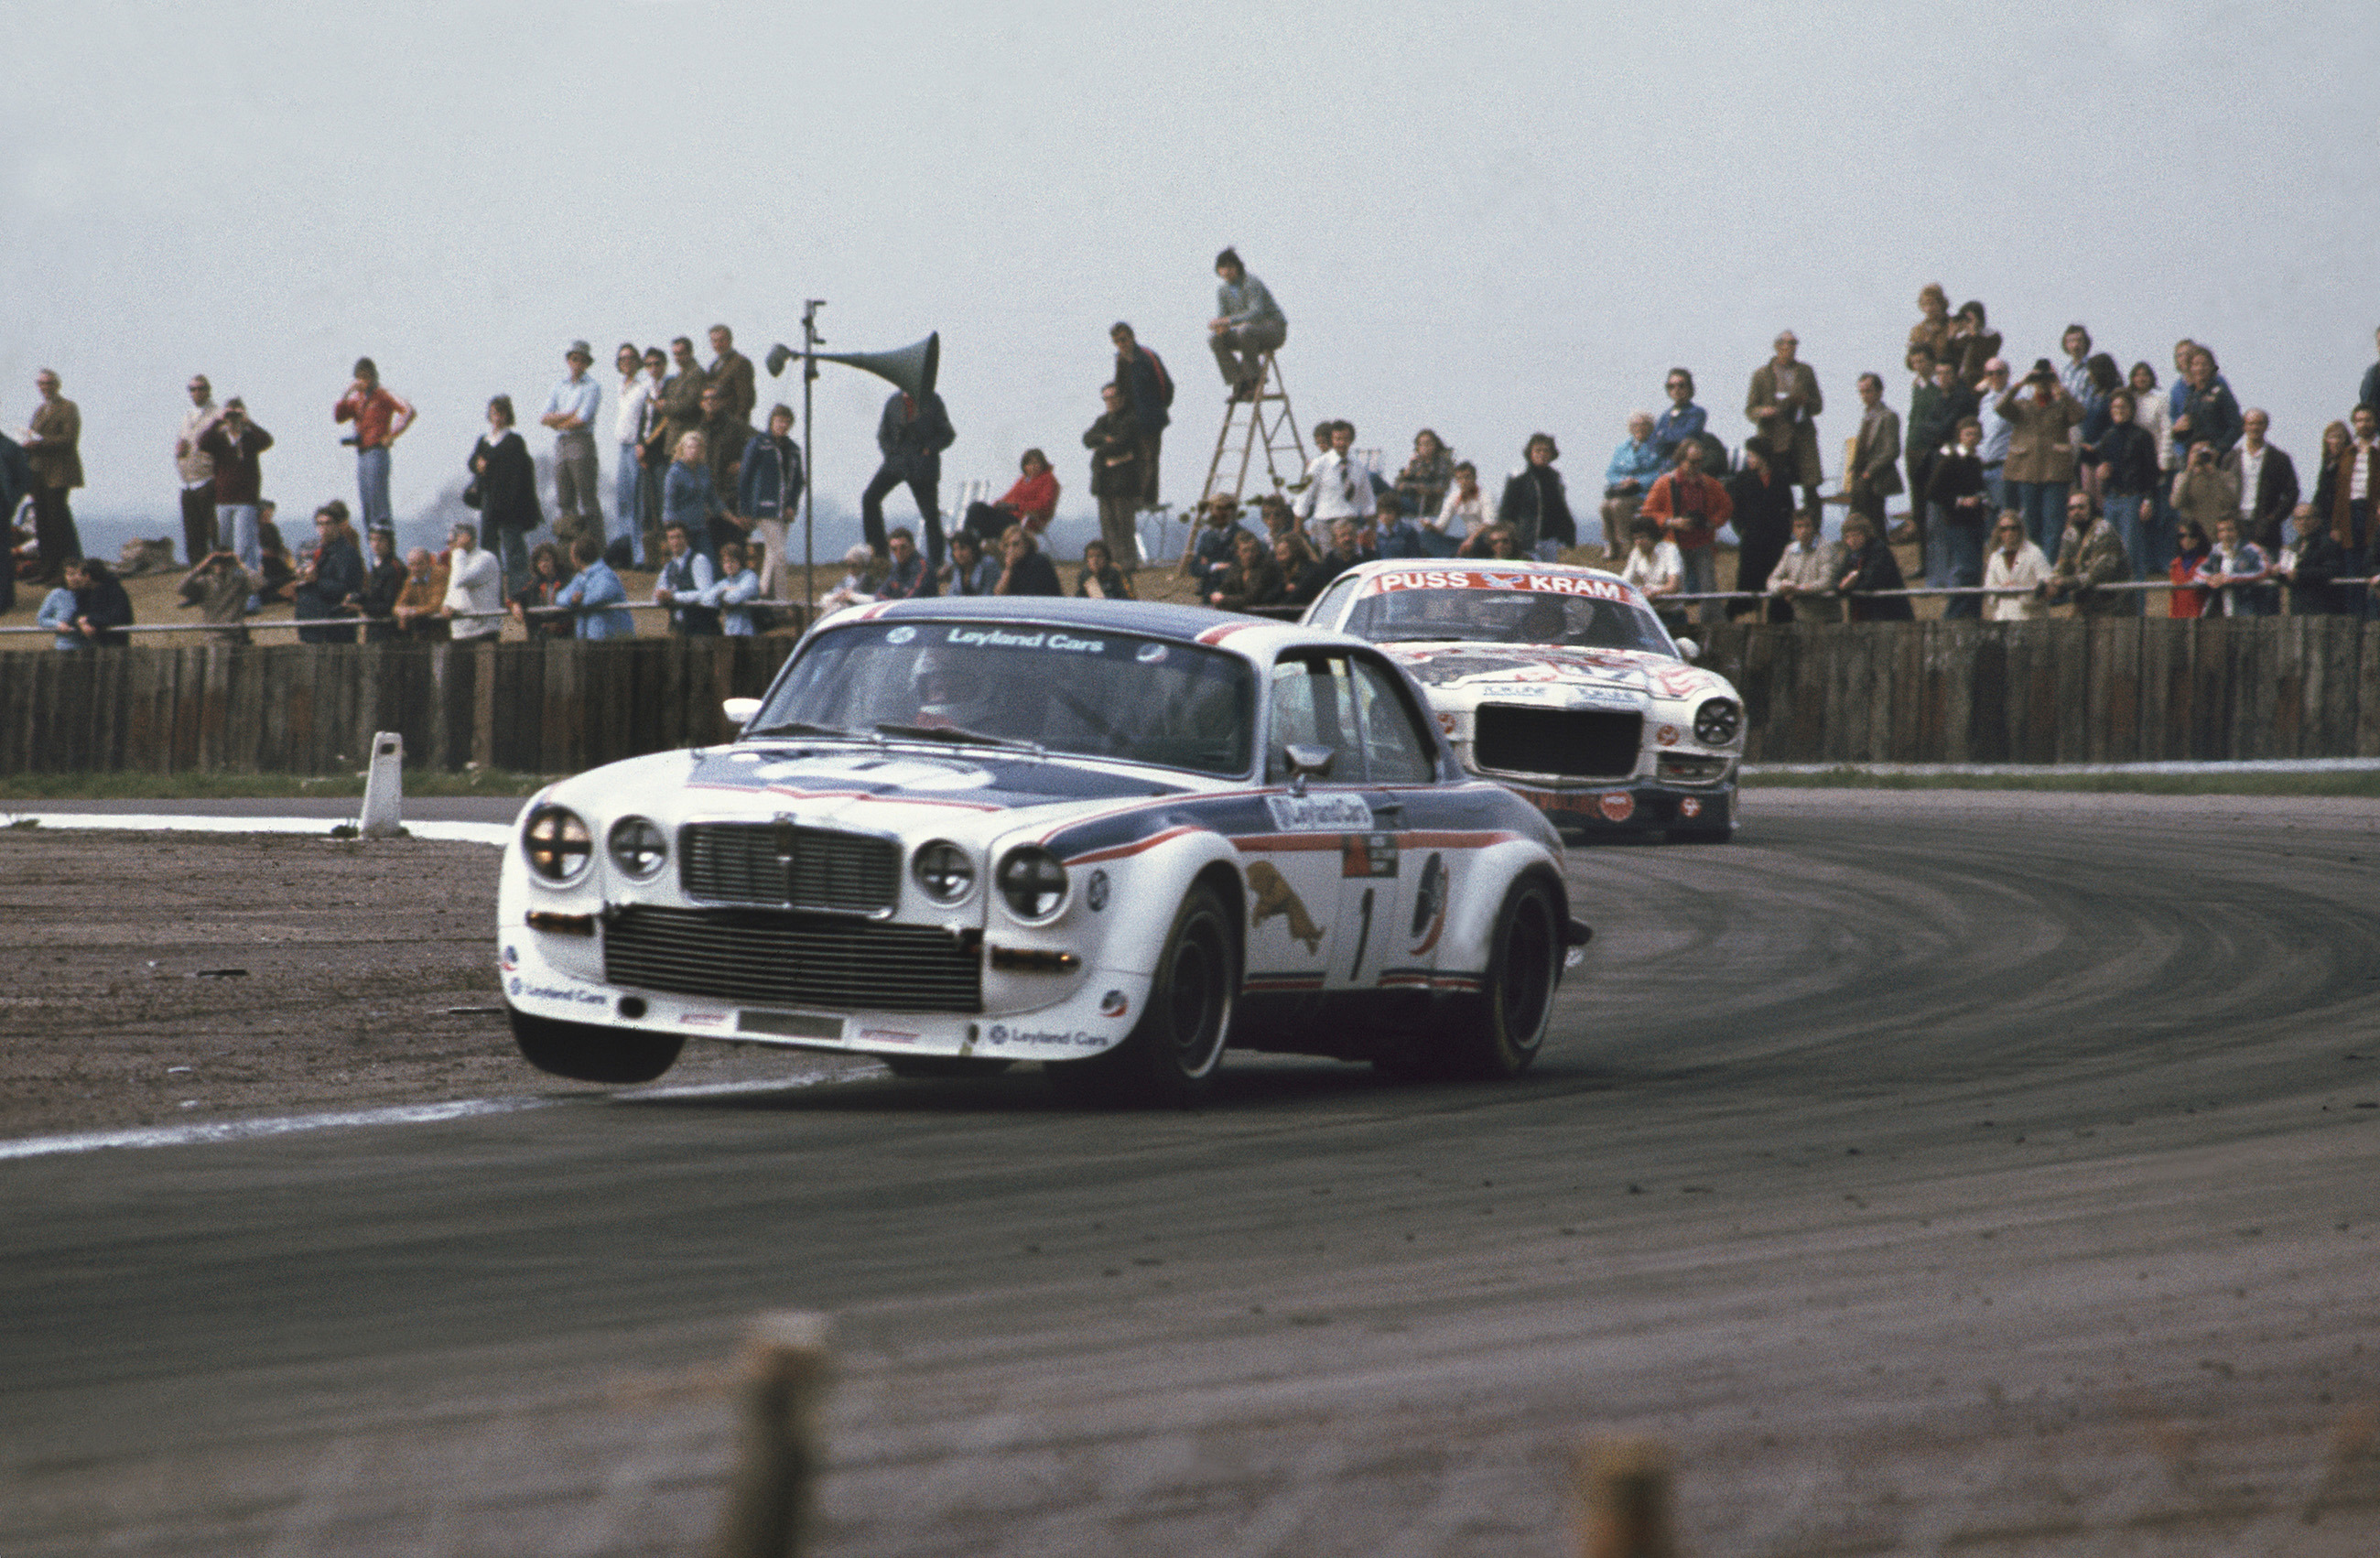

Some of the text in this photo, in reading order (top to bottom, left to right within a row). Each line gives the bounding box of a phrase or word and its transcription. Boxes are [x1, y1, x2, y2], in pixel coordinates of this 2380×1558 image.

[1381, 572, 1620, 599] PUSS KRAM
[947, 628, 1105, 652] Leyland Cars
